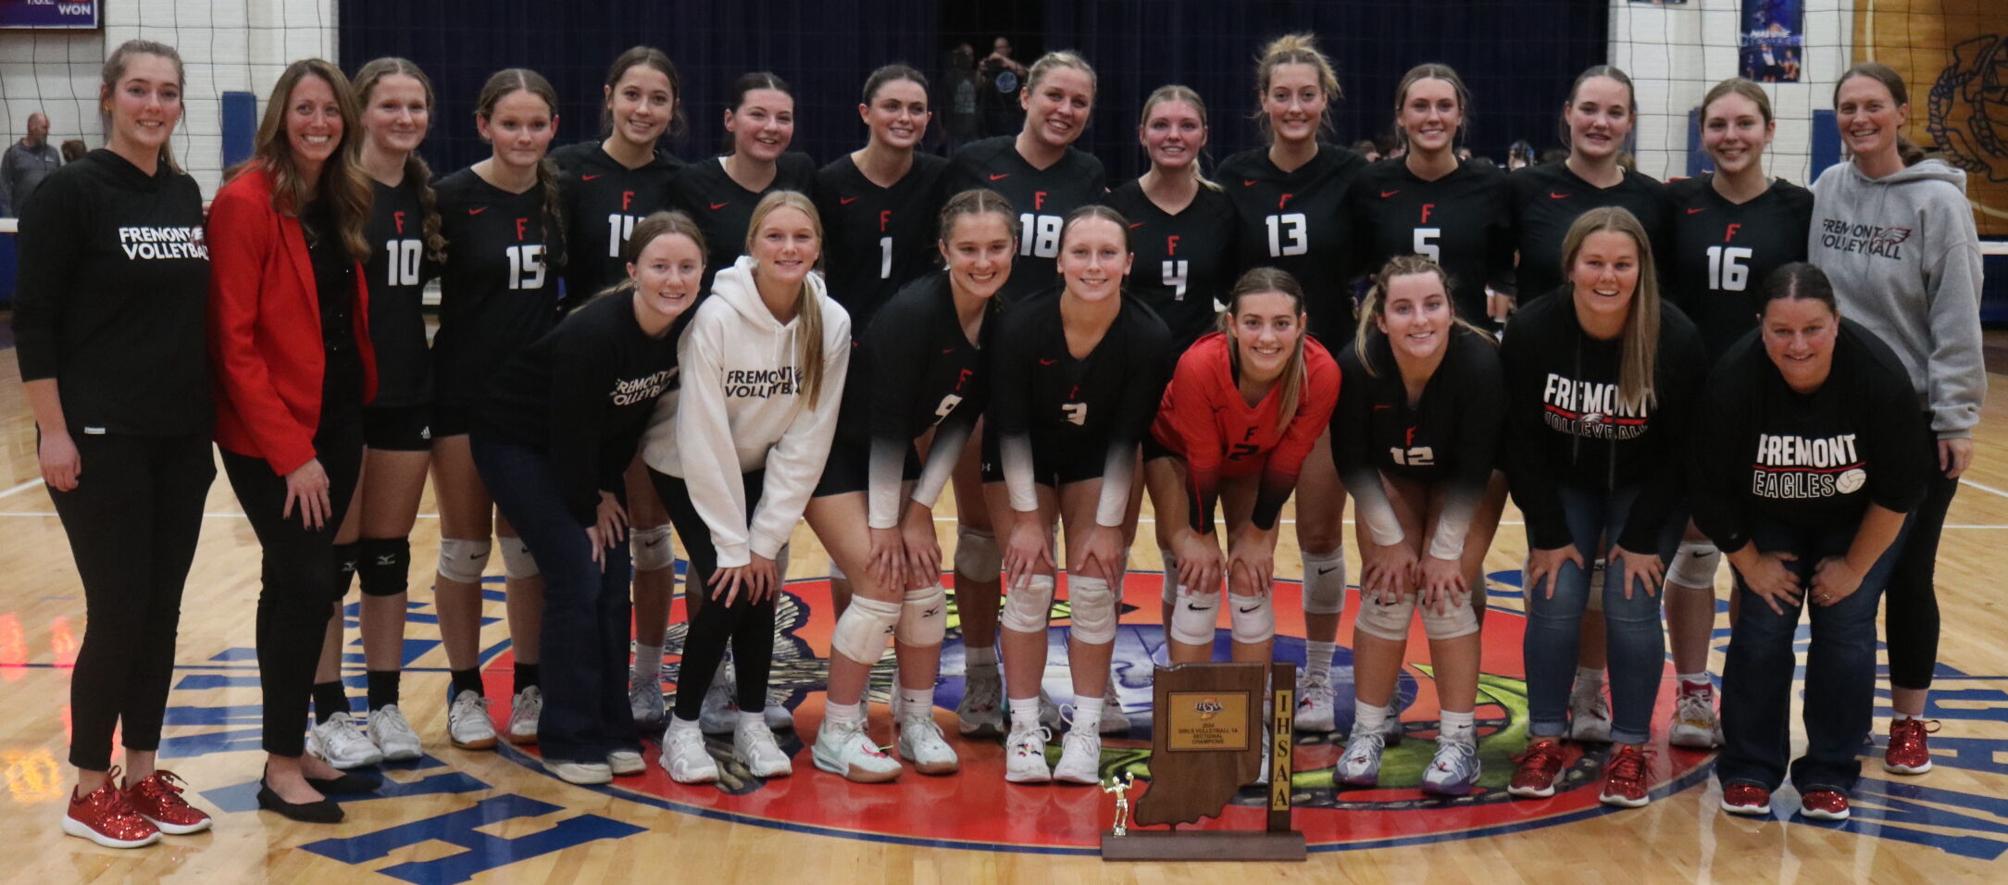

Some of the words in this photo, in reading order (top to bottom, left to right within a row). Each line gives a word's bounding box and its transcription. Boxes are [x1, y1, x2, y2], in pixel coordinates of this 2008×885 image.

[58, 4, 91, 15] WON
[623, 191, 635, 211] F
[1035, 191, 1047, 211] F
[393, 211, 405, 234] F
[879, 210, 892, 232] F
[1420, 204, 1435, 224] F
[119, 227, 190, 243] FREMONT
[516, 217, 528, 240] F
[1020, 213, 1064, 258] 18
[1265, 213, 1308, 257] 13
[1724, 223, 1742, 243] F
[879, 237, 893, 279] 1
[1168, 236, 1180, 256] F
[1413, 228, 1441, 265] 5
[386, 239, 423, 286] 10
[506, 244, 547, 290] 15
[1706, 246, 1753, 292] 16
[1162, 260, 1188, 301] 4
[1060, 402, 1088, 426] 3
[1389, 446, 1435, 466] 12
[1756, 433, 1858, 468] FREMONT
[1752, 470, 1836, 499] EAGLES
[1274, 695, 1291, 806] IHSAA
